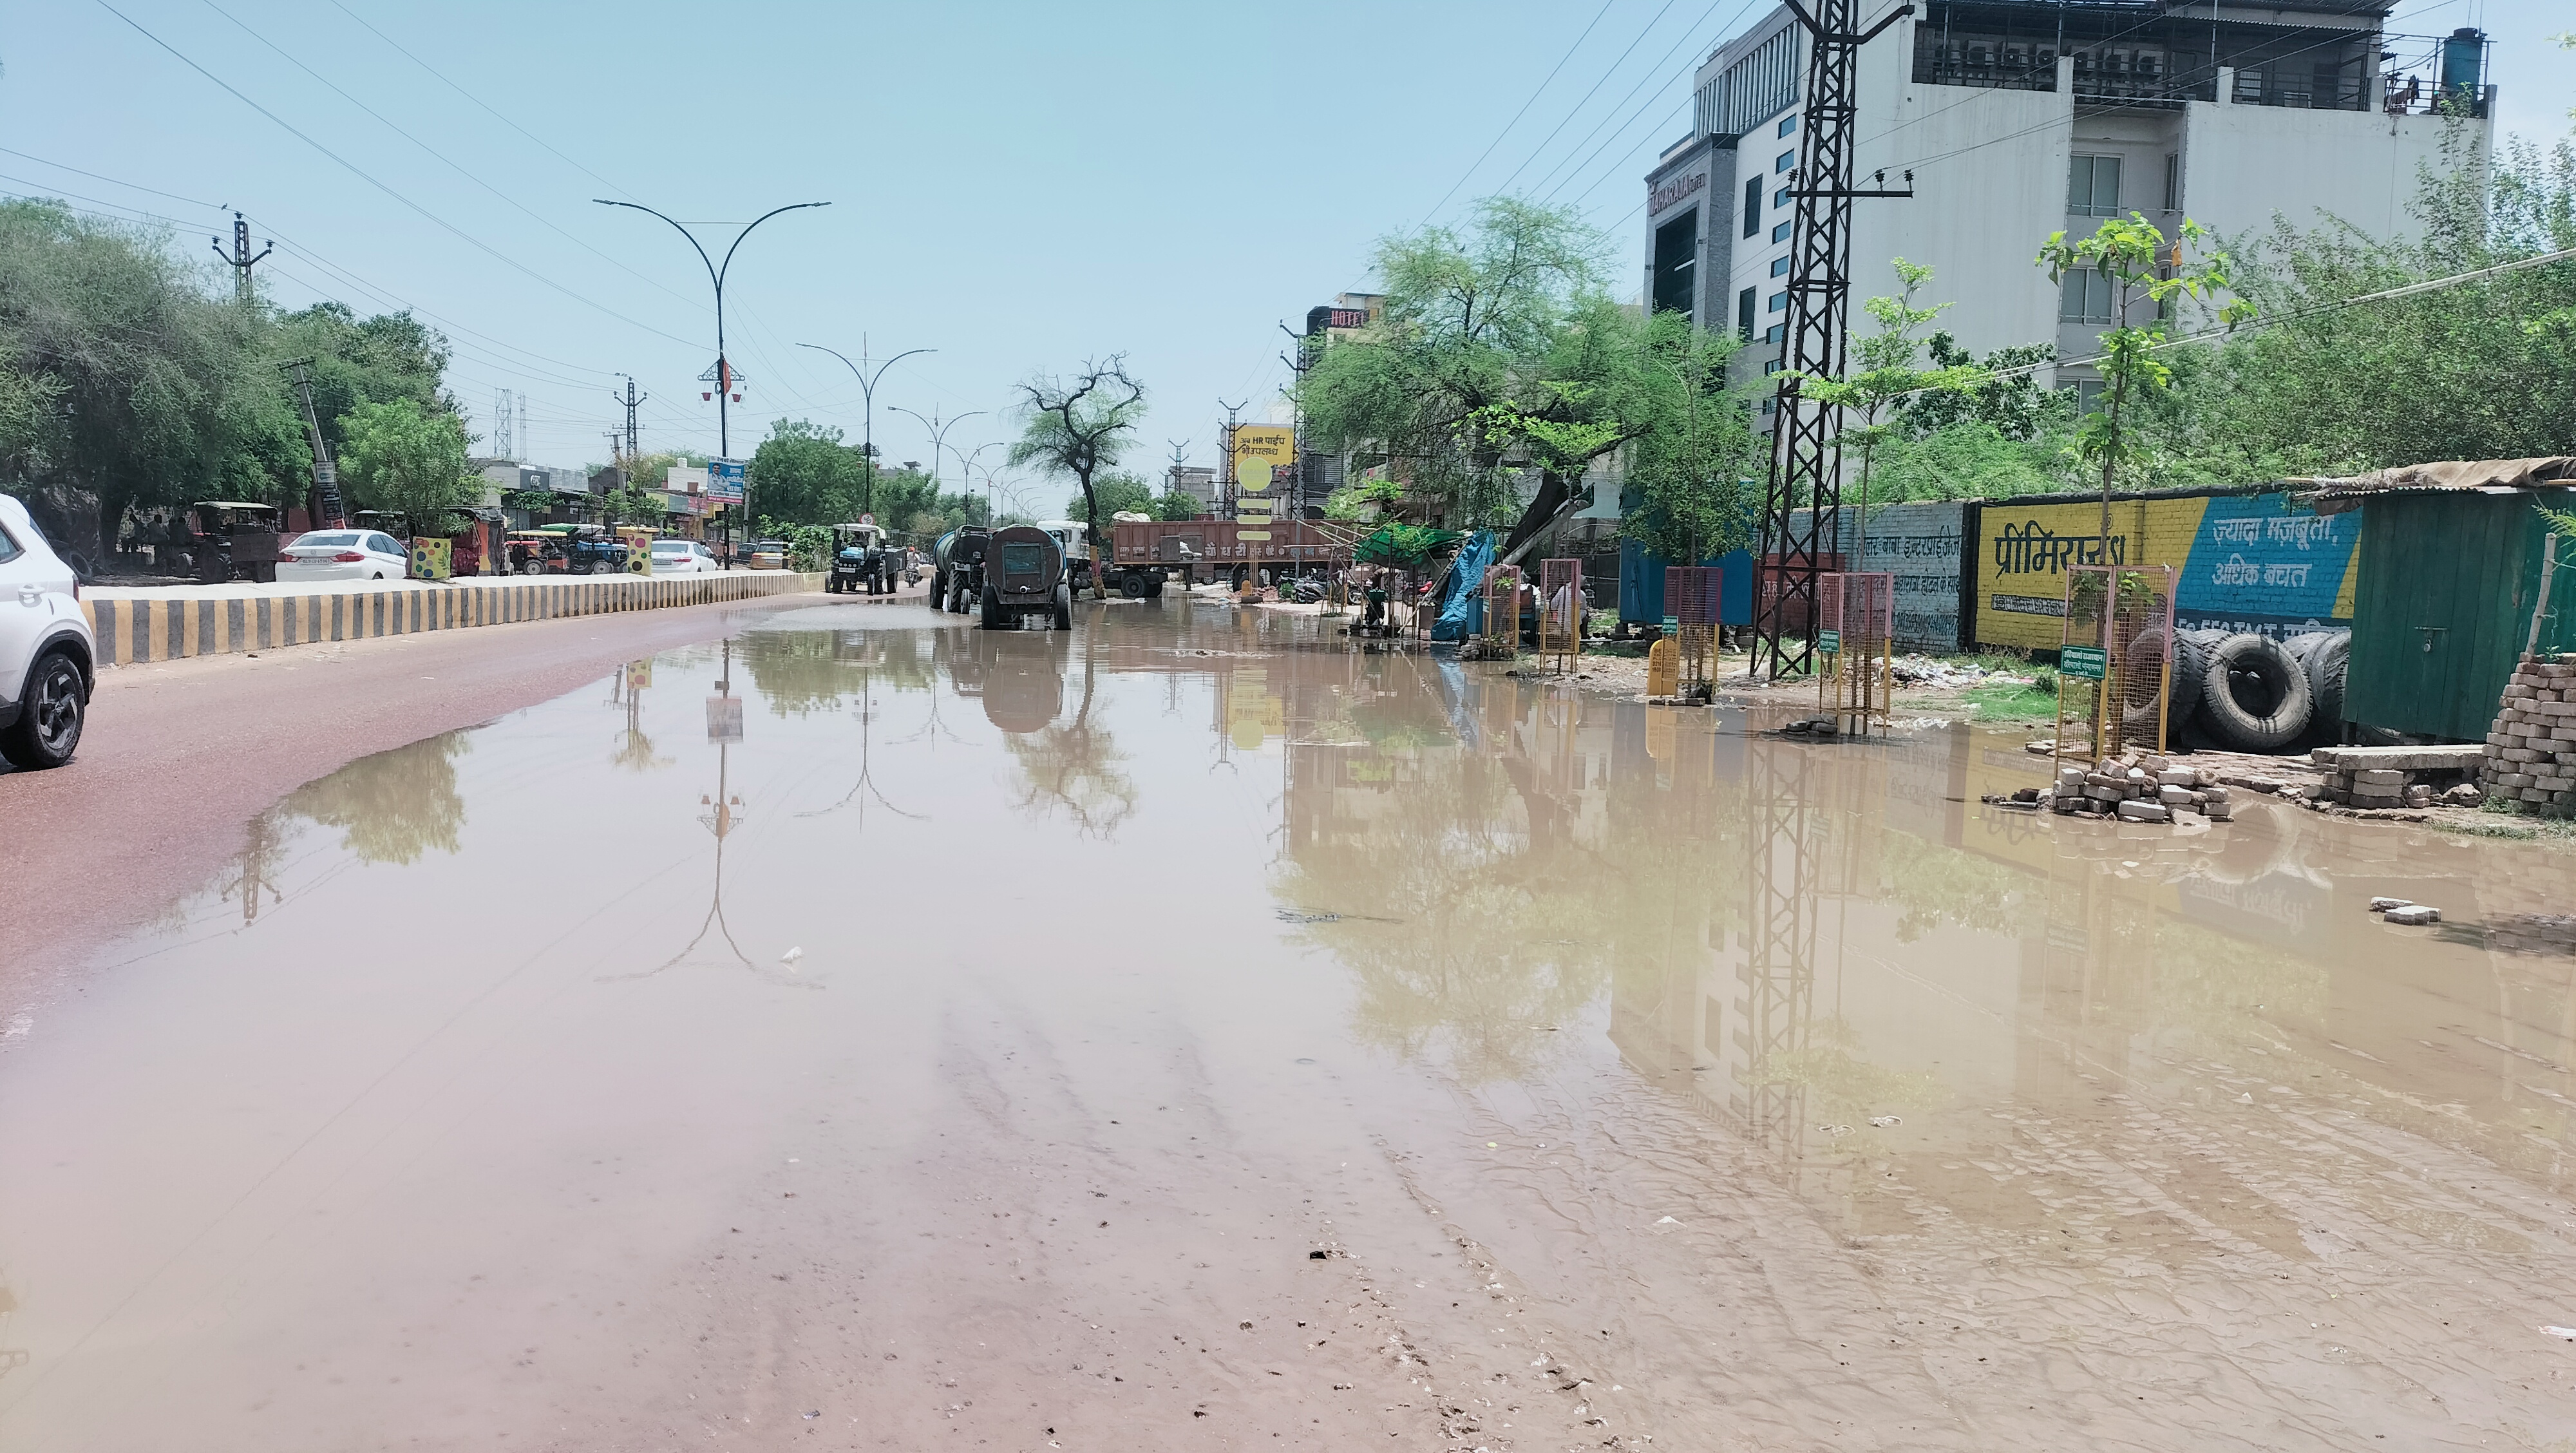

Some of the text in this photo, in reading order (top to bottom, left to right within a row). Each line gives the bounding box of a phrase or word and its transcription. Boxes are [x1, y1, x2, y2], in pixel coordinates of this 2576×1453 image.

[1649, 175, 1690, 217] MAHARAJA
[1250, 447, 1279, 455] उपलब्ध
[1253, 436, 1264, 444] HR
[1265, 434, 1286, 446] पाईप
[2211, 553, 2313, 588] अधिक बचत
